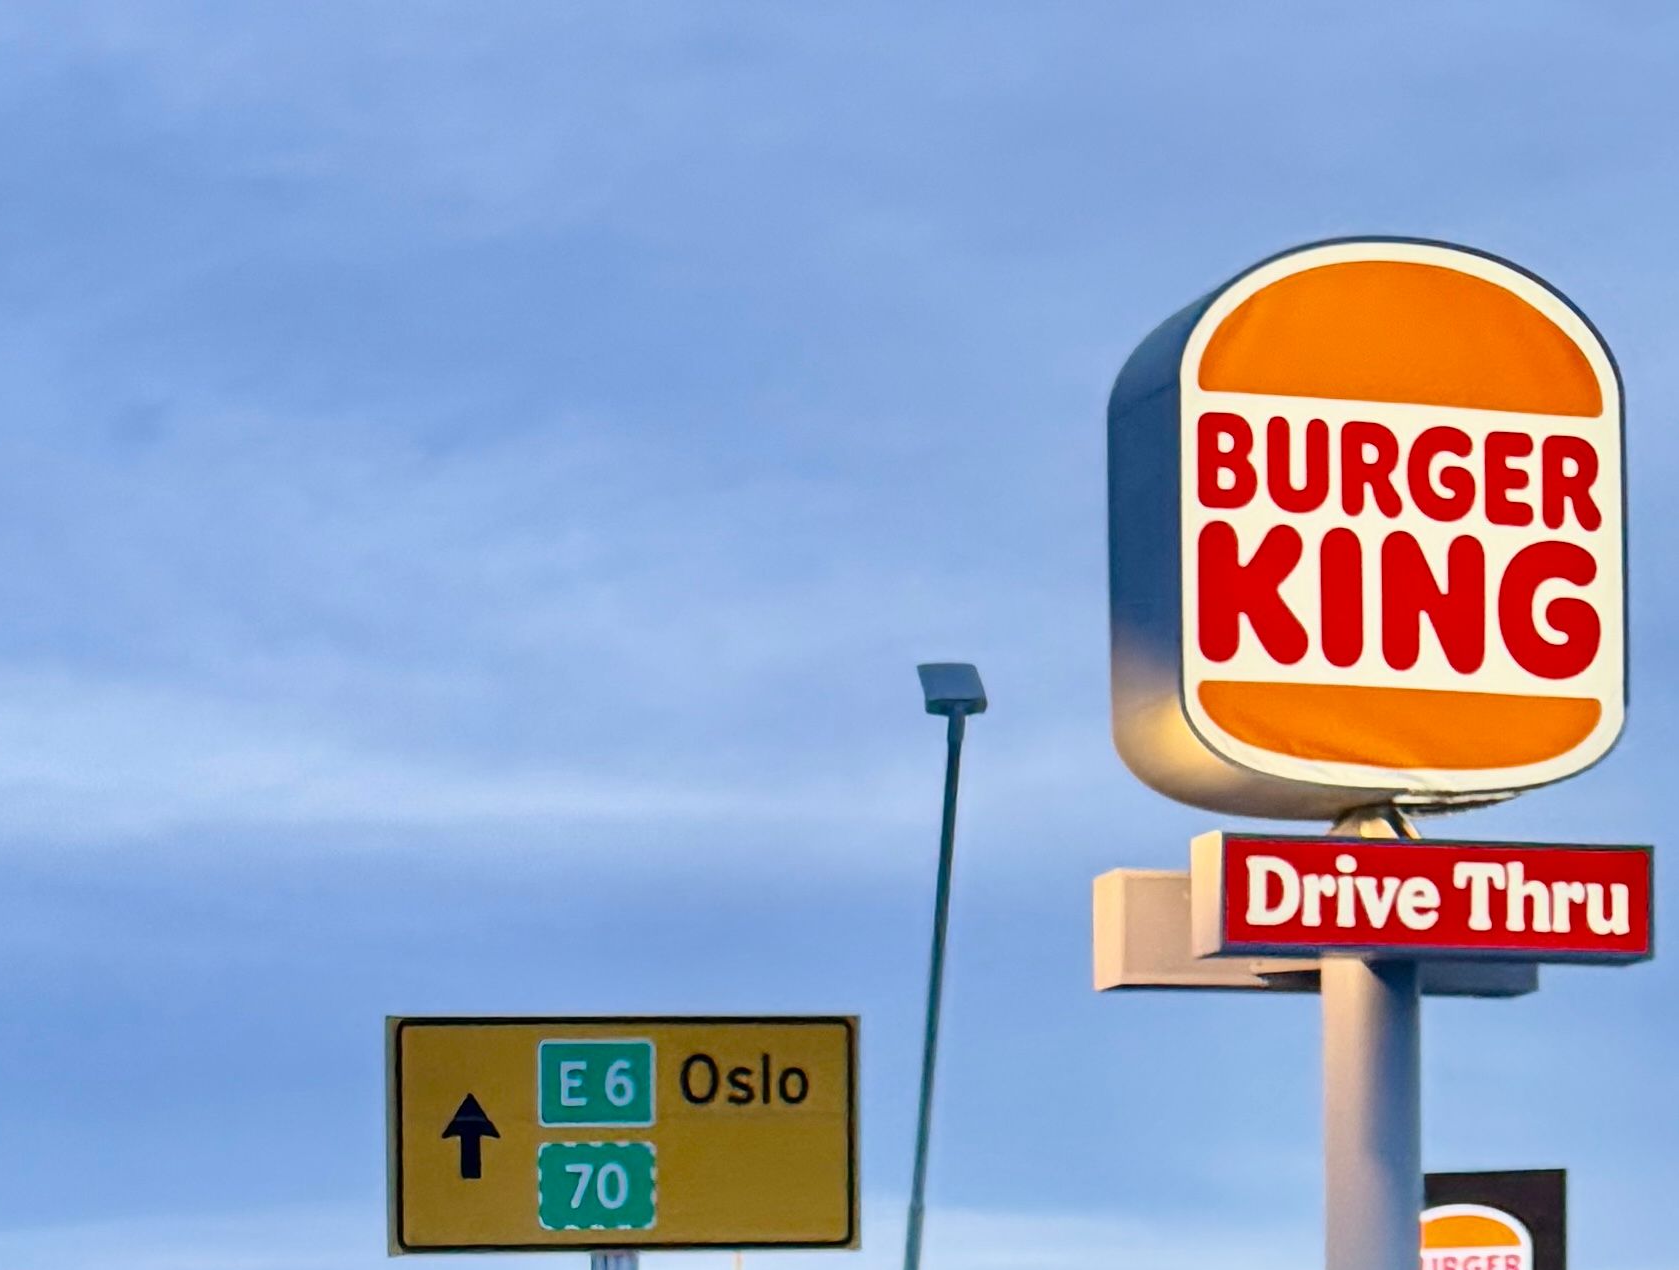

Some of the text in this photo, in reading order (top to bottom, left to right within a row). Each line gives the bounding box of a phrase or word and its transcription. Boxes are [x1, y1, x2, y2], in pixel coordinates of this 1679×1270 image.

[1197, 411, 1602, 532] BURGER
[1197, 519, 1602, 681] KING
[1245, 853, 1630, 936] Drive Thru
[559, 1052, 810, 1107] E 6 Oslo
[565, 1162, 629, 1209] 70
